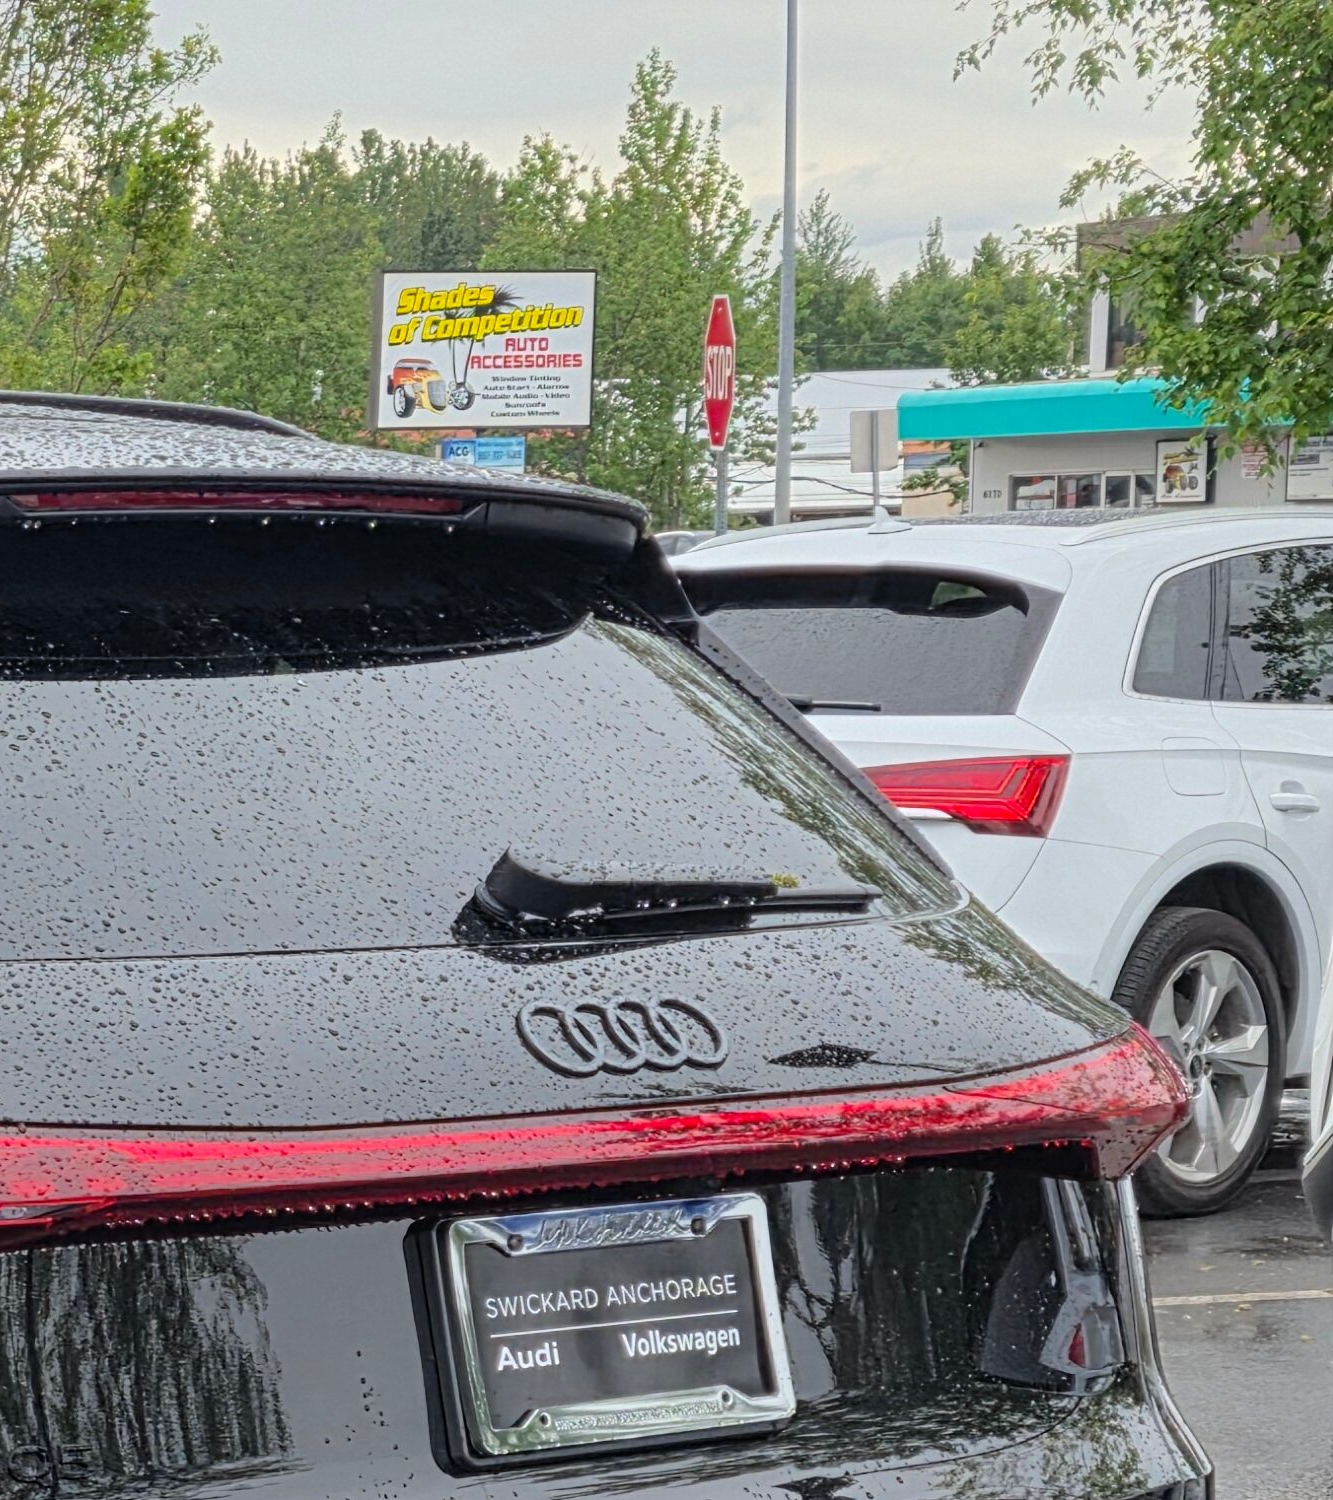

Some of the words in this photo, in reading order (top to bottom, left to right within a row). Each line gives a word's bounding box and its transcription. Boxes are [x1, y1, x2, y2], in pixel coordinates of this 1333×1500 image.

[396, 282, 497, 316] Shades
[388, 316, 421, 346] of
[421, 303, 585, 343] Competition
[470, 354, 583, 369] ACCESSORIES
[505, 337, 549, 352] AUTO
[707, 345, 733, 400] STOP
[448, 446, 469, 457] ACG
[485, 1288, 599, 1319] SWICKARD
[607, 1274, 737, 1307] ANCHORAGE
[497, 1341, 560, 1371] Audi
[621, 1326, 741, 1358] Volkswagen
